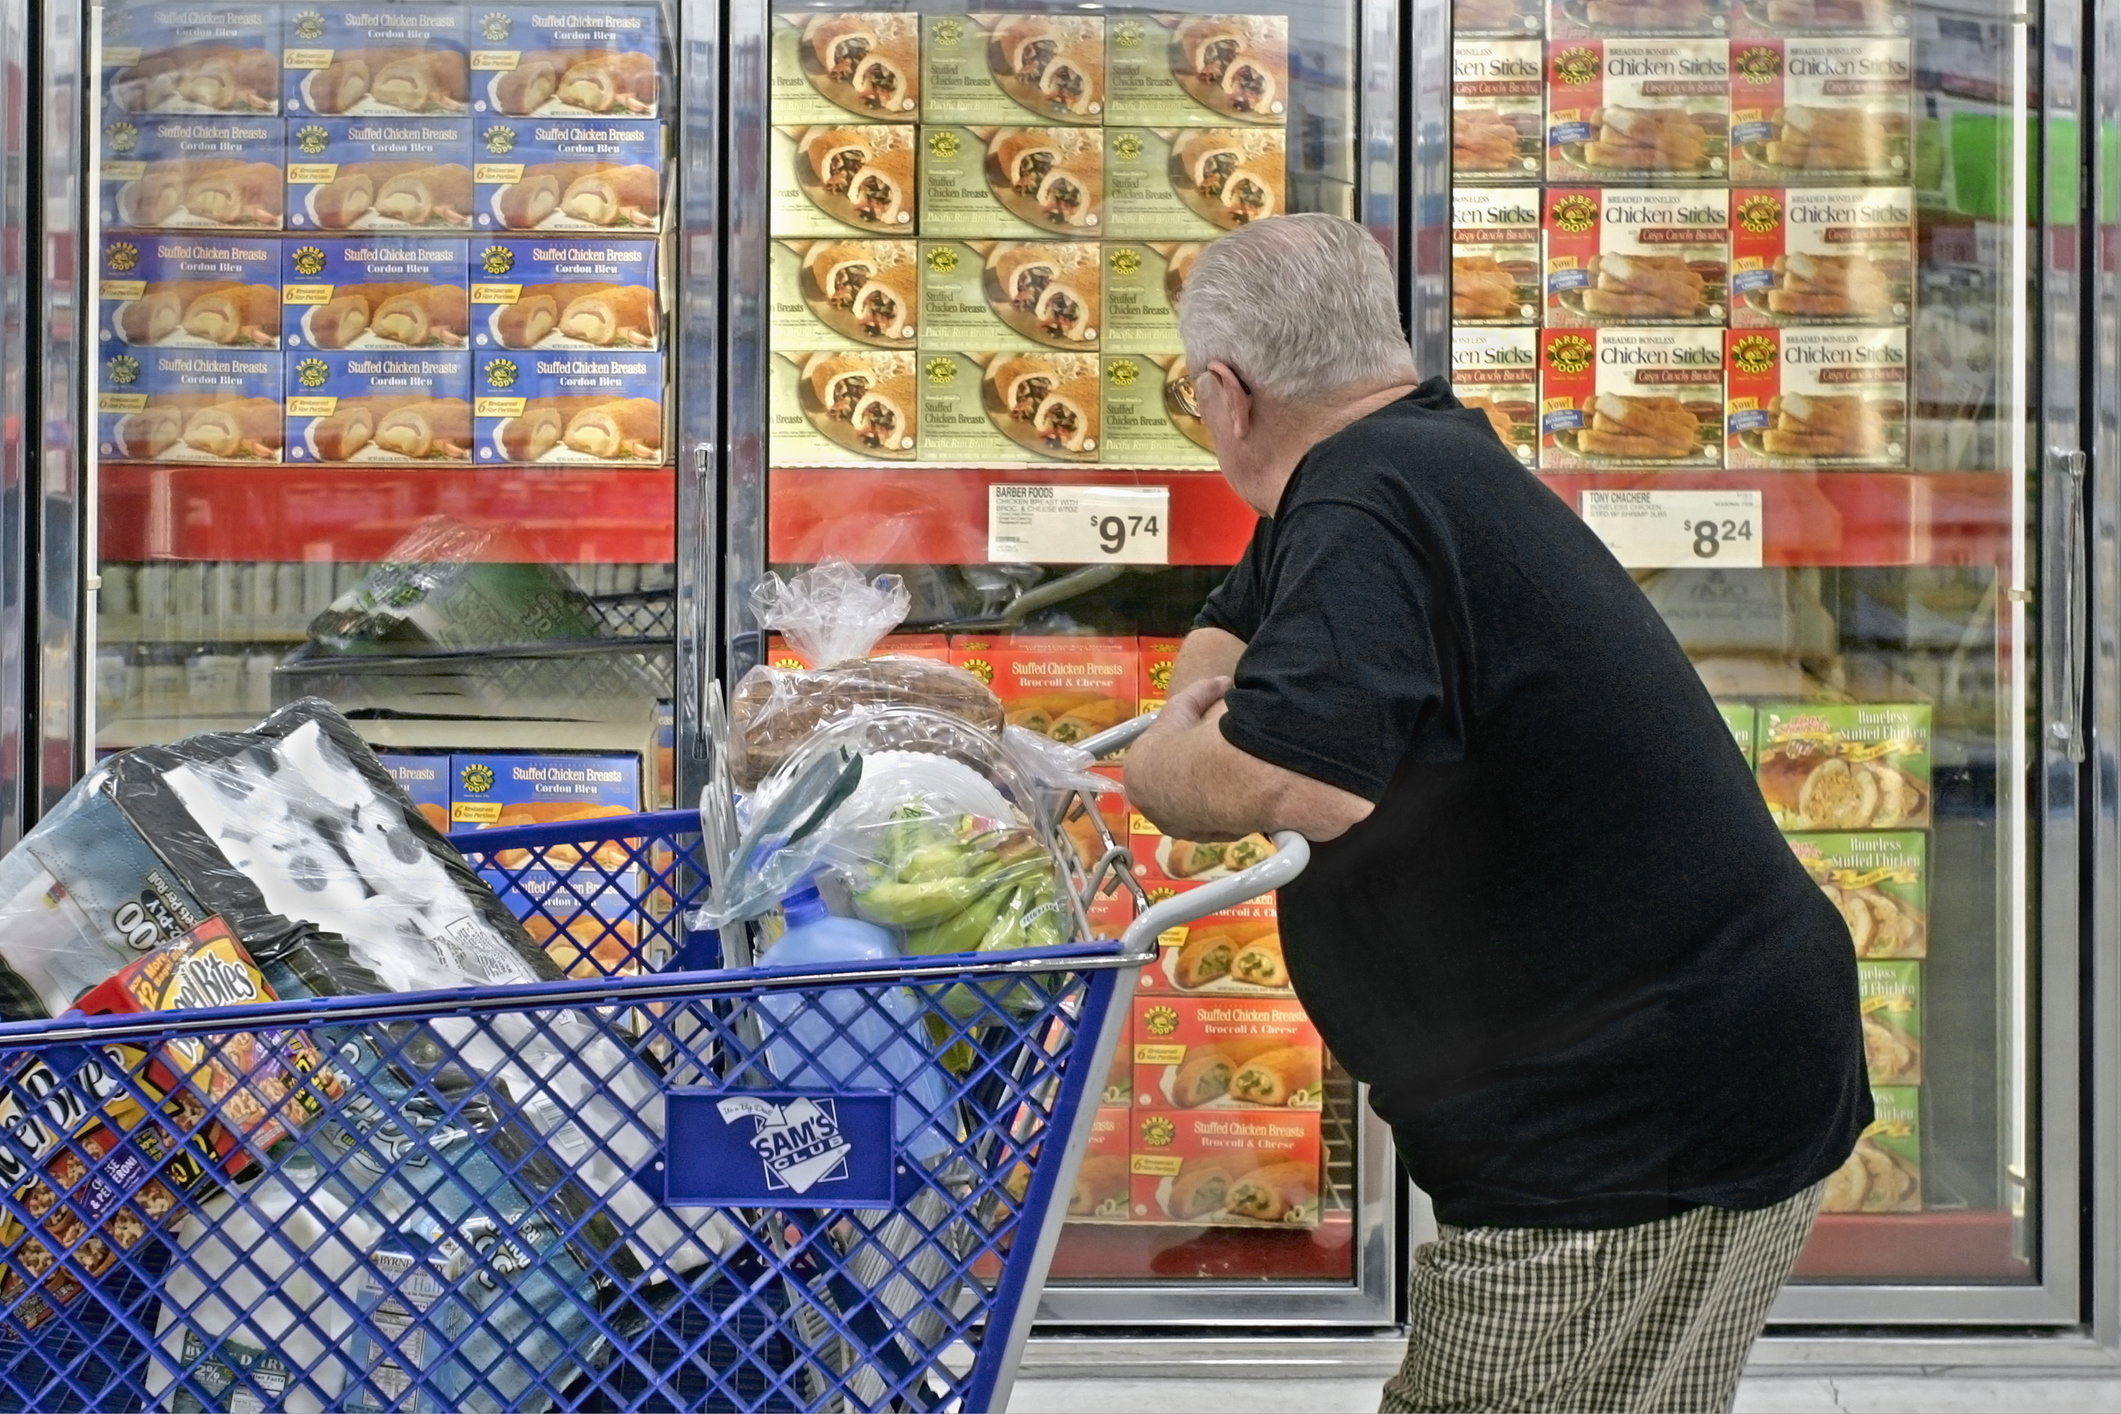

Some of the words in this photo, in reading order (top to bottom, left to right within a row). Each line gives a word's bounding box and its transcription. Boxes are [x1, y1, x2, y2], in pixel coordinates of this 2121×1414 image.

[1489, 59, 1538, 76] Sticks
[1608, 60, 1674, 76] Chicken
[1680, 60, 1727, 76] Sticks
[536, 128, 569, 141] Stuffed
[571, 129, 607, 141] Chicken
[609, 129, 644, 142] Breasts
[558, 144, 593, 153] Cordon
[597, 144, 619, 153] Bleu
[928, 176, 955, 186] Stuffed
[928, 188, 959, 197] Chicken
[961, 189, 987, 197] Breasts
[1606, 207, 1672, 223] Chicken
[1678, 207, 1725, 224] Sticks
[1791, 207, 1856, 222] Chicken
[1861, 207, 1907, 223] Sticks
[158, 246, 191, 259] Stuffed
[193, 247, 230, 259] Chicken
[232, 248, 267, 260] Breasts
[344, 248, 377, 261] Stuffed
[379, 249, 417, 262] Chicken
[419, 250, 454, 262] Breasts
[481, 245, 514, 258] BARBER
[533, 248, 566, 261] Stuffed
[568, 249, 605, 261] Chicken
[607, 250, 642, 262] Breasts
[180, 262, 216, 271] Cordon
[220, 263, 242, 272] Bleu
[367, 264, 403, 273] Cordon
[407, 265, 429, 274] Bleu
[484, 265, 510, 274] FOODS
[556, 264, 591, 273] Cordon
[595, 265, 617, 274] Bleu
[926, 292, 953, 301] Stuffed
[776, 303, 804, 314] Breasts
[926, 303, 957, 313] Chicken
[959, 304, 986, 313] Breasts
[1548, 335, 1593, 352] BARBER
[1732, 334, 1777, 351] BARBER
[1601, 348, 1667, 364] Chicken
[1672, 348, 1720, 364] Sticks
[1785, 347, 1850, 363] Chicken
[1856, 347, 1903, 363] Sticks
[348, 360, 381, 373] Stuffed
[383, 361, 420, 373] Chicken
[422, 362, 457, 374] Breasts
[537, 361, 570, 374] Stuffed
[572, 362, 610, 375] Chicken
[612, 363, 647, 375] Breasts
[1551, 361, 1590, 373] FOODS
[1735, 360, 1774, 372] FOODS
[370, 376, 406, 385] Cordon
[410, 377, 432, 386] Bleu
[560, 377, 596, 386] Cordon
[600, 378, 622, 387] Bleu
[925, 402, 952, 412] Stuffed
[1107, 404, 1134, 414] Stuffed
[775, 413, 803, 424] Breasts
[925, 414, 956, 423] Chicken
[958, 415, 984, 423] Breasts
[1107, 416, 1138, 425] Chicken
[1140, 417, 1166, 425] Breasts
[996, 487, 1027, 499] BARBER
[1029, 487, 1054, 499] FOODS
[1589, 492, 1609, 503] TONY
[1611, 492, 1651, 504] CHACHERE
[1012, 662, 1046, 674] Stuffed
[1048, 662, 1085, 675] Chicken
[1087, 663, 1122, 675] Breasts
[1020, 678, 1062, 687] Broccoli
[1065, 678, 1073, 687] &
[1077, 678, 1113, 687] Cheese
[1858, 710, 1908, 725] Boneless
[1840, 726, 1879, 741] Stuffed
[1883, 725, 1927, 739] Chicken
[400, 767, 434, 780] Breasts
[461, 764, 494, 777] BARBER
[513, 767, 546, 780] Stuffed
[548, 768, 585, 780] Chicken
[587, 769, 622, 781] Breasts
[464, 784, 490, 793] FOODS
[536, 783, 571, 792] Cordon
[575, 784, 597, 793] Bleu
[454, 805, 462, 818] 6
[1850, 837, 1902, 851] Boneless
[1832, 853, 1873, 868] Stuffed
[1875, 853, 1920, 867] Chicken
[147, 871, 169, 894] Roll
[166, 889, 180, 912] Per
[178, 904, 199, 928] eets
[143, 952, 170, 980] More
[188, 949, 258, 1006] Bites
[1198, 1009, 1231, 1021] Stuffed
[1233, 1009, 1270, 1022] Chicken
[1272, 1010, 1307, 1022] Breasts
[1205, 1025, 1247, 1034] Broccoli
[1250, 1025, 1258, 1034] &
[1262, 1025, 1298, 1034] Cheese
[1194, 1122, 1228, 1134] Stuffed
[1230, 1122, 1267, 1135] Chicken
[1269, 1123, 1304, 1135] Breasts
[756, 1115, 837, 1160] SAM'S
[1202, 1139, 1244, 1148] Broccoli
[1247, 1139, 1255, 1148] &
[1259, 1139, 1295, 1148] Cheese
[774, 1135, 844, 1171] CLUB
